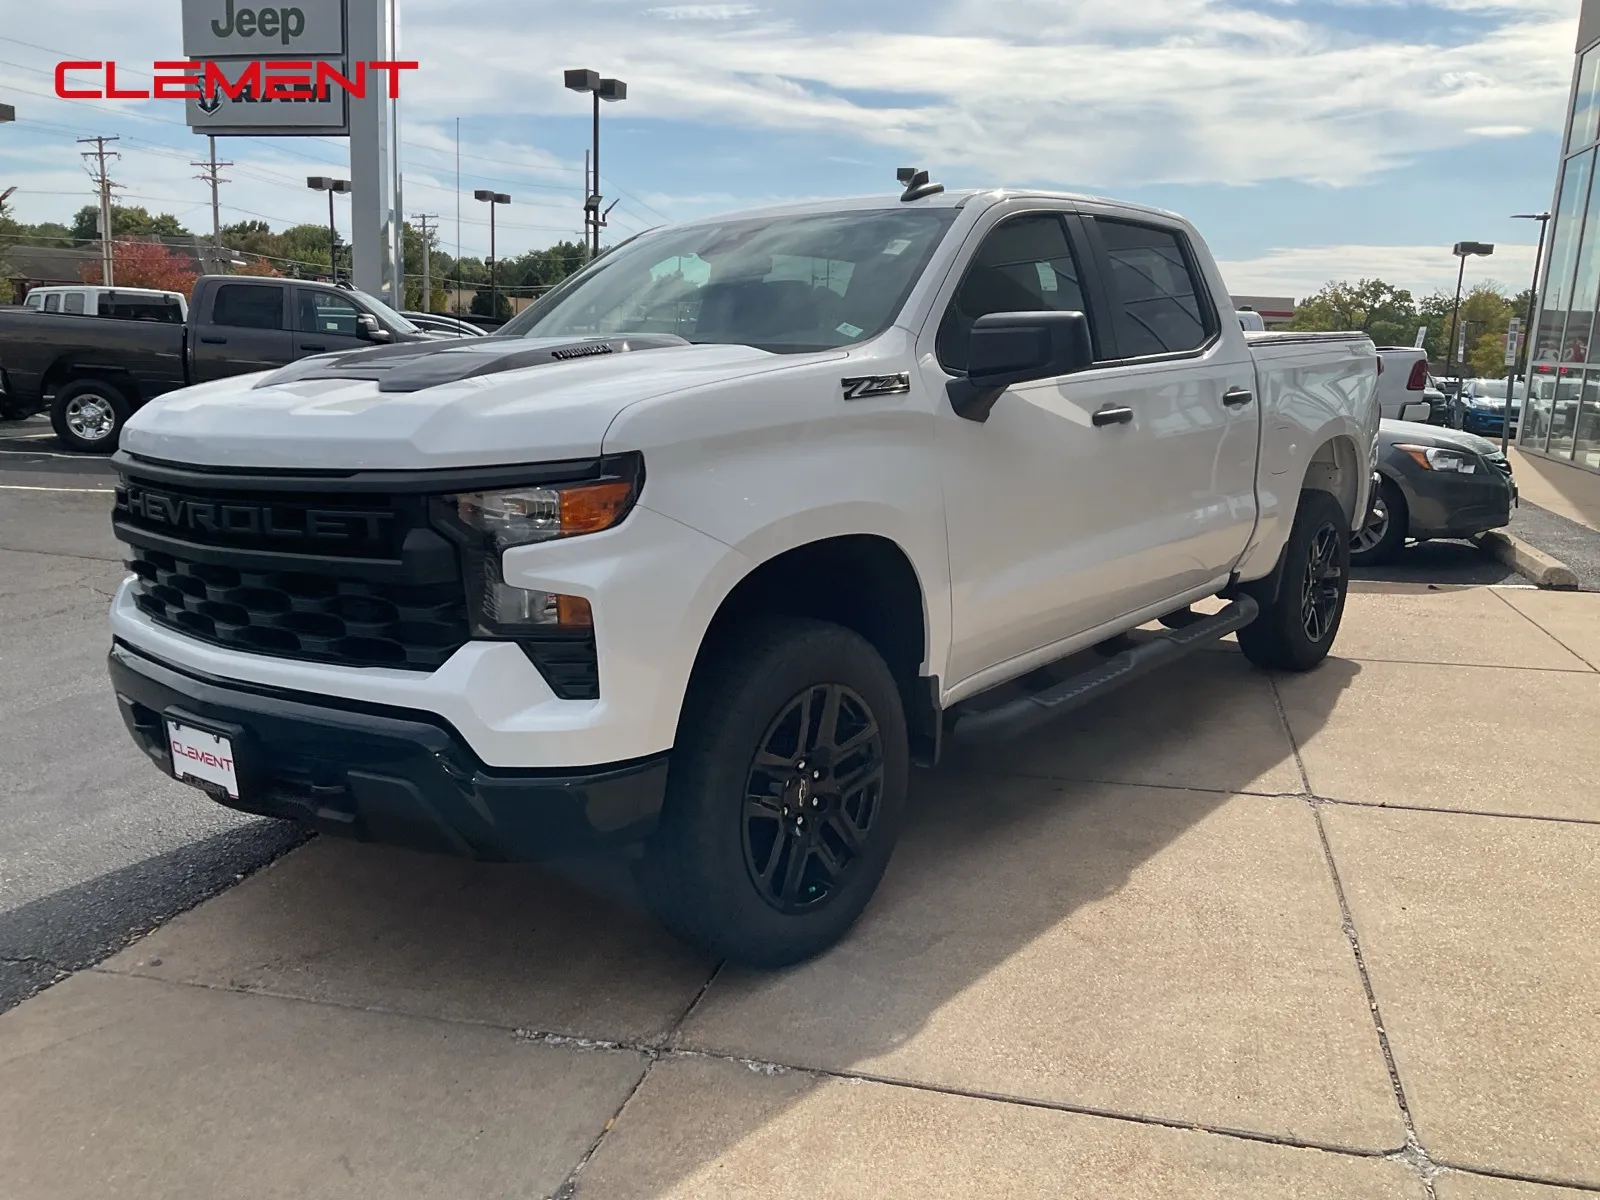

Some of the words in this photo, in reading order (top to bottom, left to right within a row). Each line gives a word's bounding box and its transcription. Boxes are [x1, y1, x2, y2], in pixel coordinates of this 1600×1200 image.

[211, 0, 305, 45] Jeep
[841, 371, 910, 401] Z71
[115, 484, 394, 540] CHEVROLET
[172, 740, 233, 772] CLEMENT
